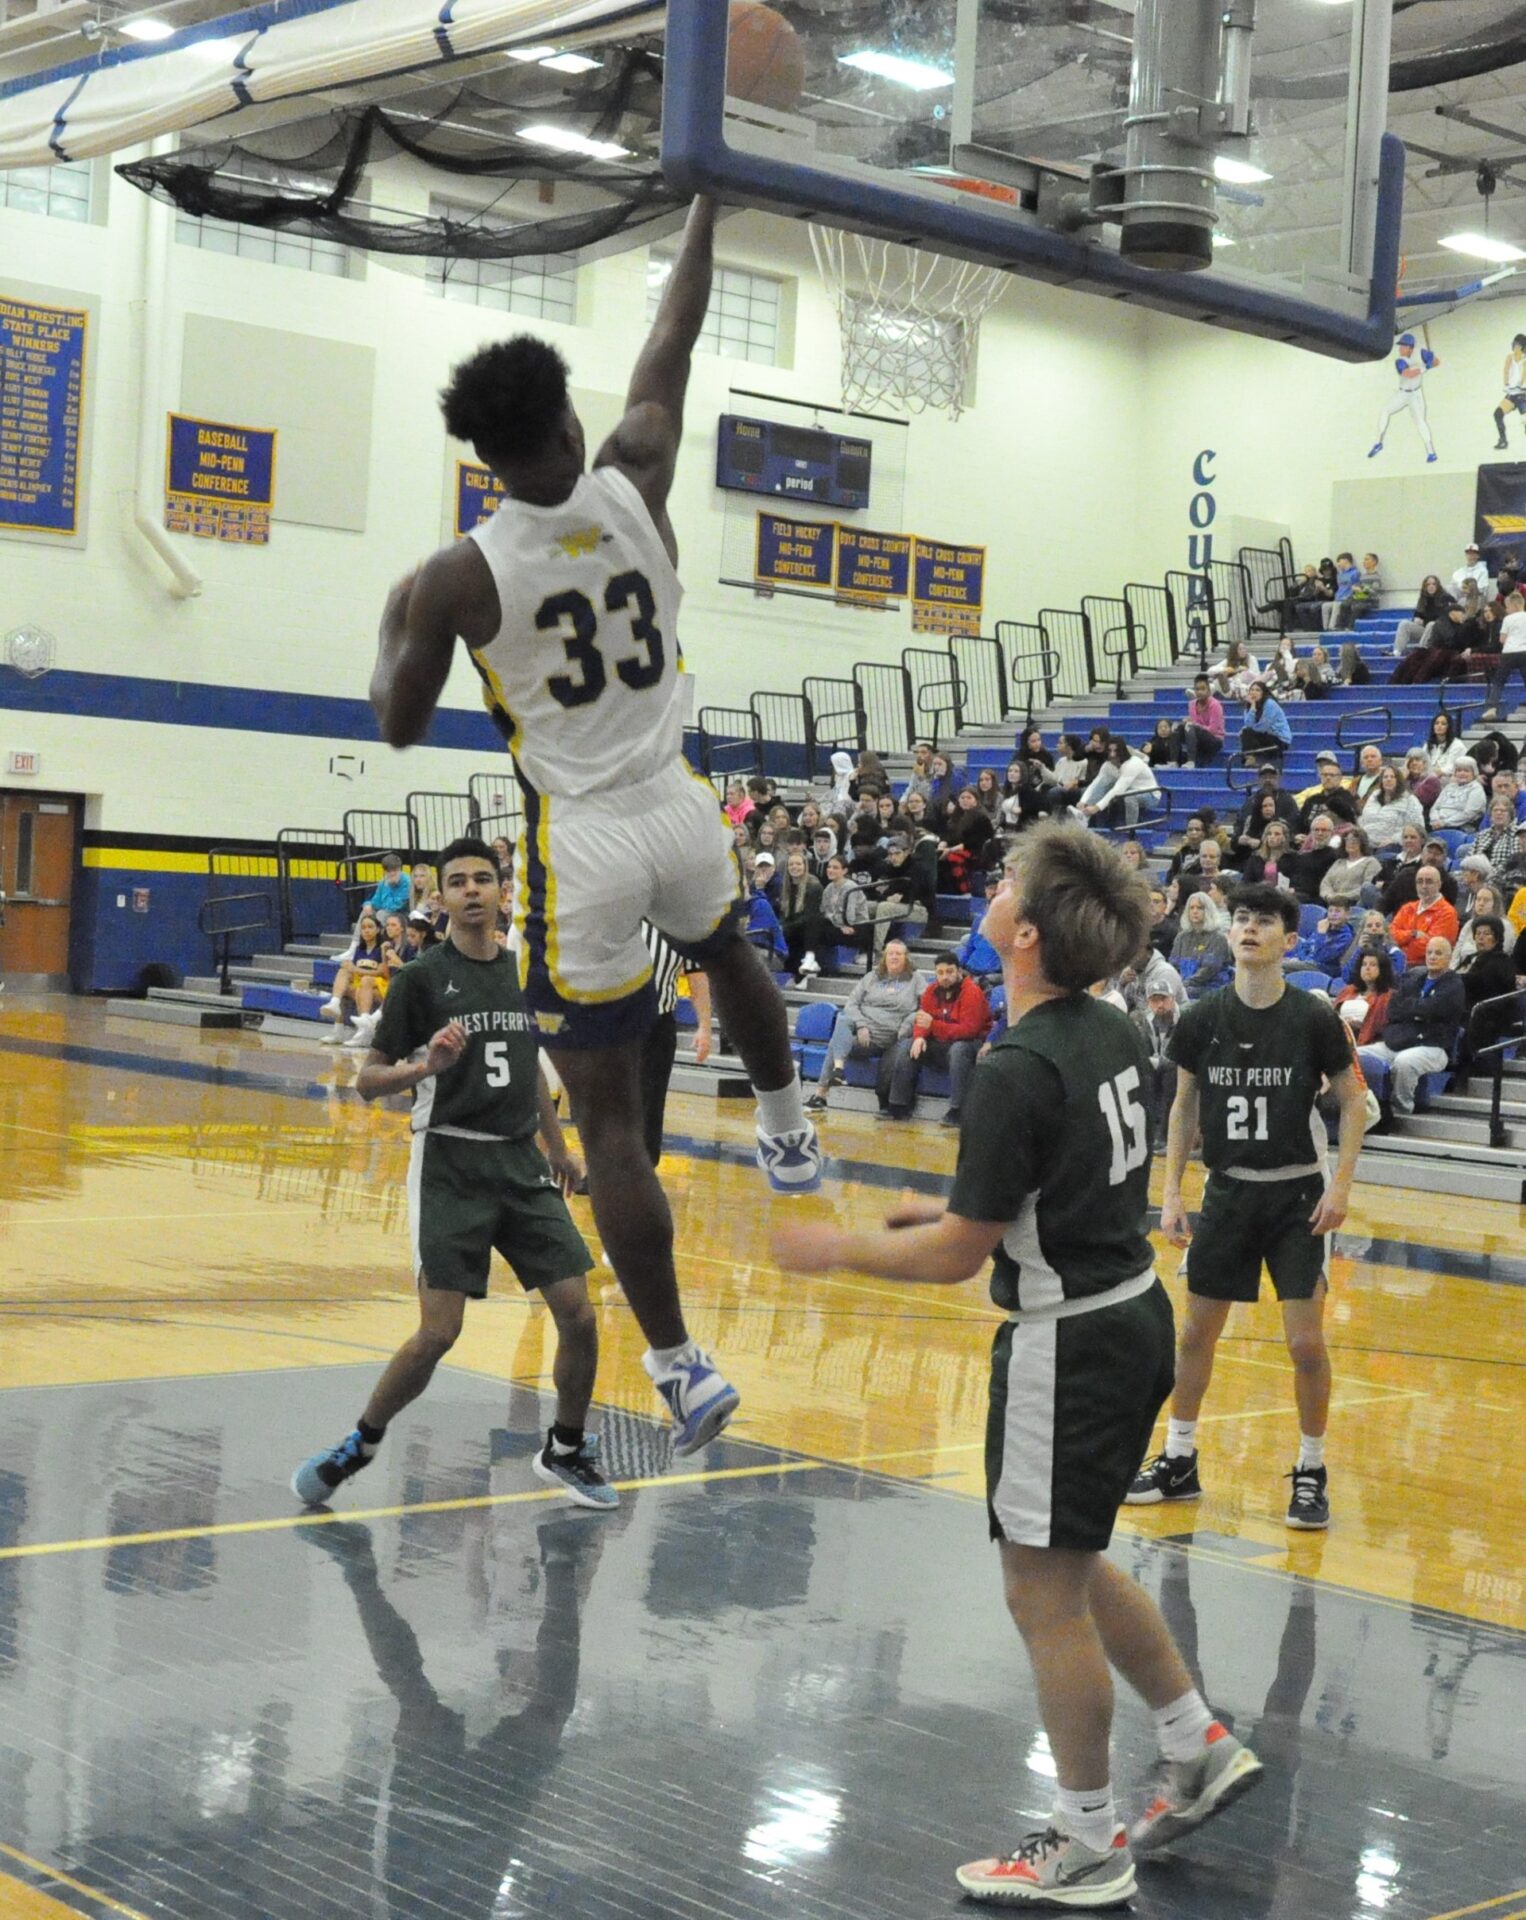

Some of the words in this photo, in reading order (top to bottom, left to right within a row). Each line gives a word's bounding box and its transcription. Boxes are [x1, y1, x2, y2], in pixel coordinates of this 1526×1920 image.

[28, 309, 84, 328] WRESTLING
[2, 318, 34, 334] STATE
[38, 325, 70, 341] PLACE
[12, 335, 60, 353] WINNERS
[736, 421, 761, 438] Home
[198, 429, 248, 452] BASEBALL
[199, 451, 245, 473] MID-PENN
[192, 472, 249, 495] CONFERENCE
[465, 472, 489, 490] GIRLS
[785, 476, 814, 491] period
[772, 522, 792, 537] FIELD
[795, 526, 821, 540] HOCKEY
[779, 541, 813, 558] MID-PENN
[859, 535, 880, 551] CROSS
[882, 539, 910, 554] COUNTRY
[857, 553, 890, 570] MID-PENN
[916, 544, 933, 560] GIRLS
[935, 548, 955, 563] CROSS
[957, 551, 982, 566] COUNTRY
[774, 559, 817, 577] CONFERENCE
[933, 565, 965, 582] MID-PENN
[853, 571, 893, 589] CONFERENCE
[929, 582, 967, 600] CONFERENCE
[535, 570, 665, 708] 33
[15, 754, 34, 771] EXIT
[484, 1041, 511, 1088] 5
[1208, 1066, 1241, 1086] WEST
[1246, 1067, 1292, 1087] PERRY
[1098, 1065, 1148, 1187] 15
[1226, 1095, 1269, 1141] 21
